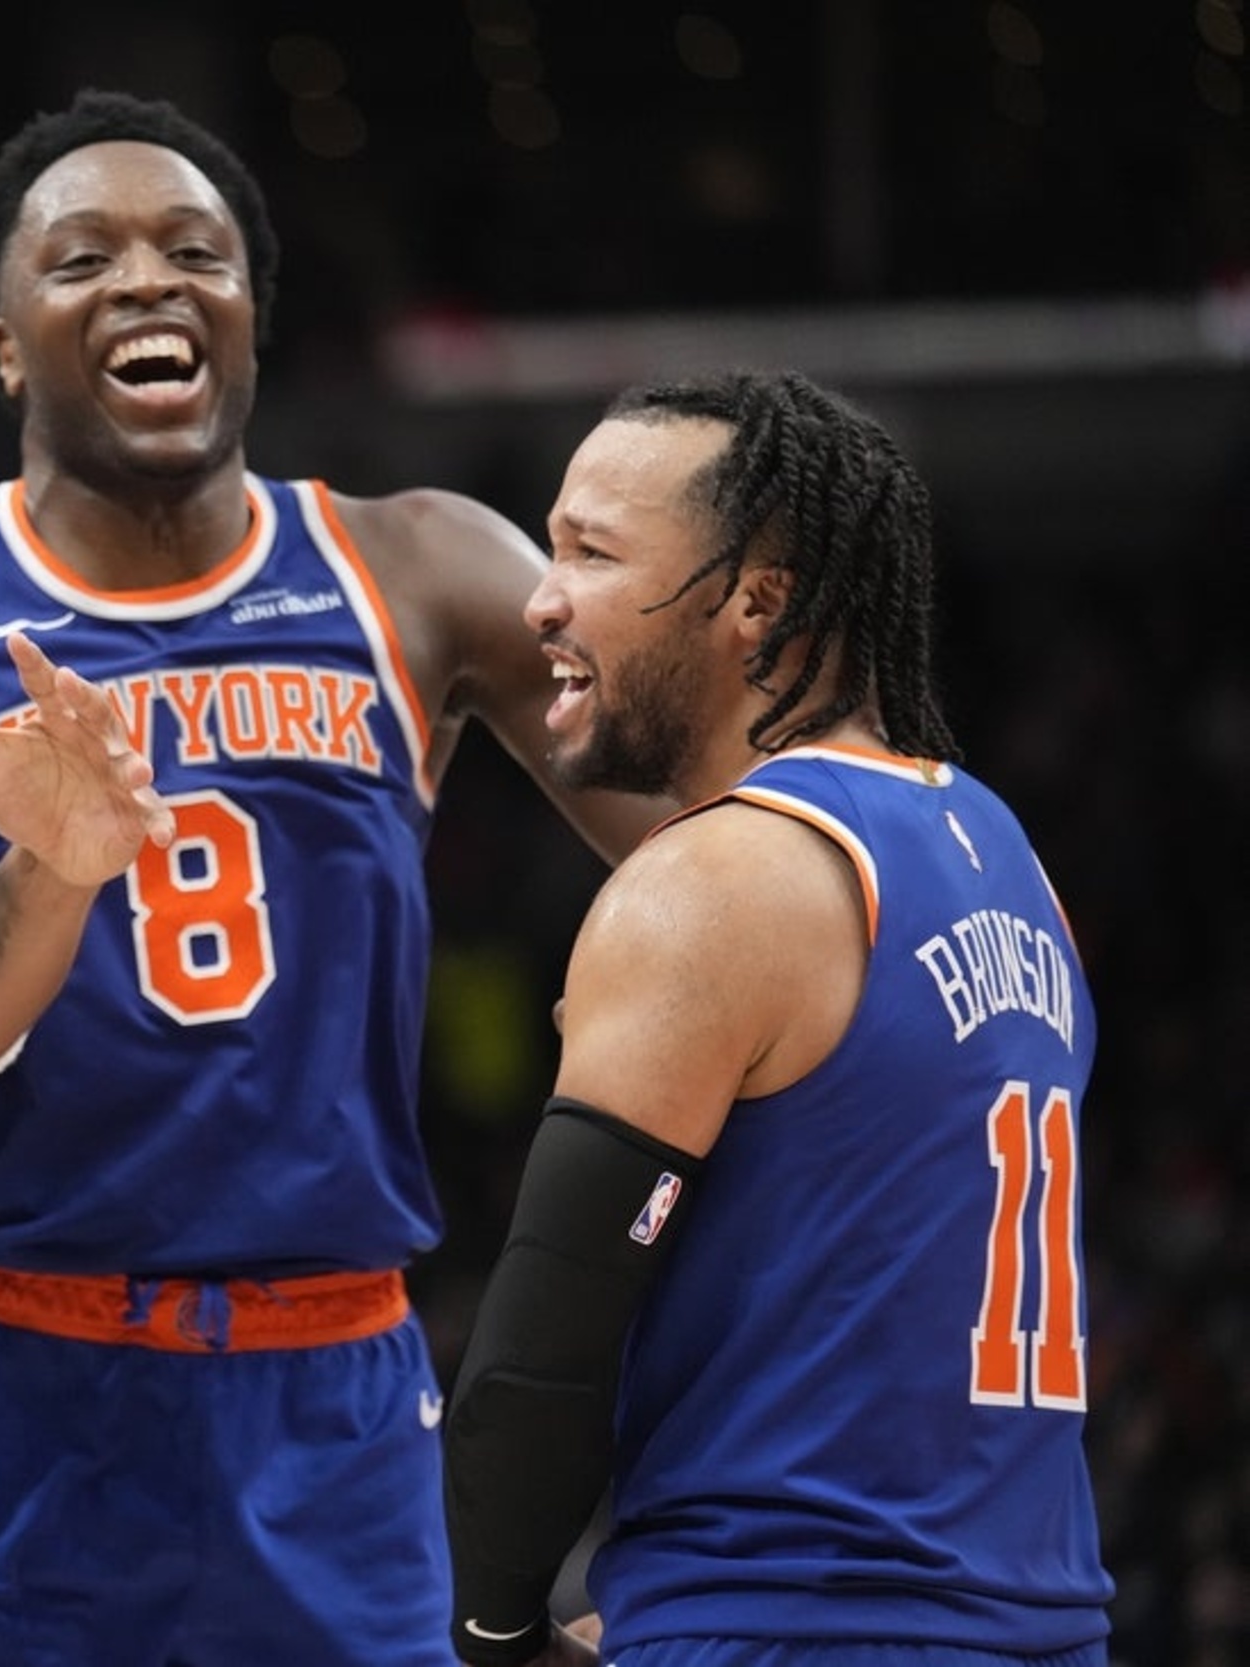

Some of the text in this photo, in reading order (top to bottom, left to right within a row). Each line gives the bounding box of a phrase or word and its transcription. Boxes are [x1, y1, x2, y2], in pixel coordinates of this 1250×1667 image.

[157, 662, 382, 777] YORK
[125, 789, 277, 1026] 8
[915, 909, 1074, 1054] BRUNSON
[970, 1080, 1088, 1413] 11
